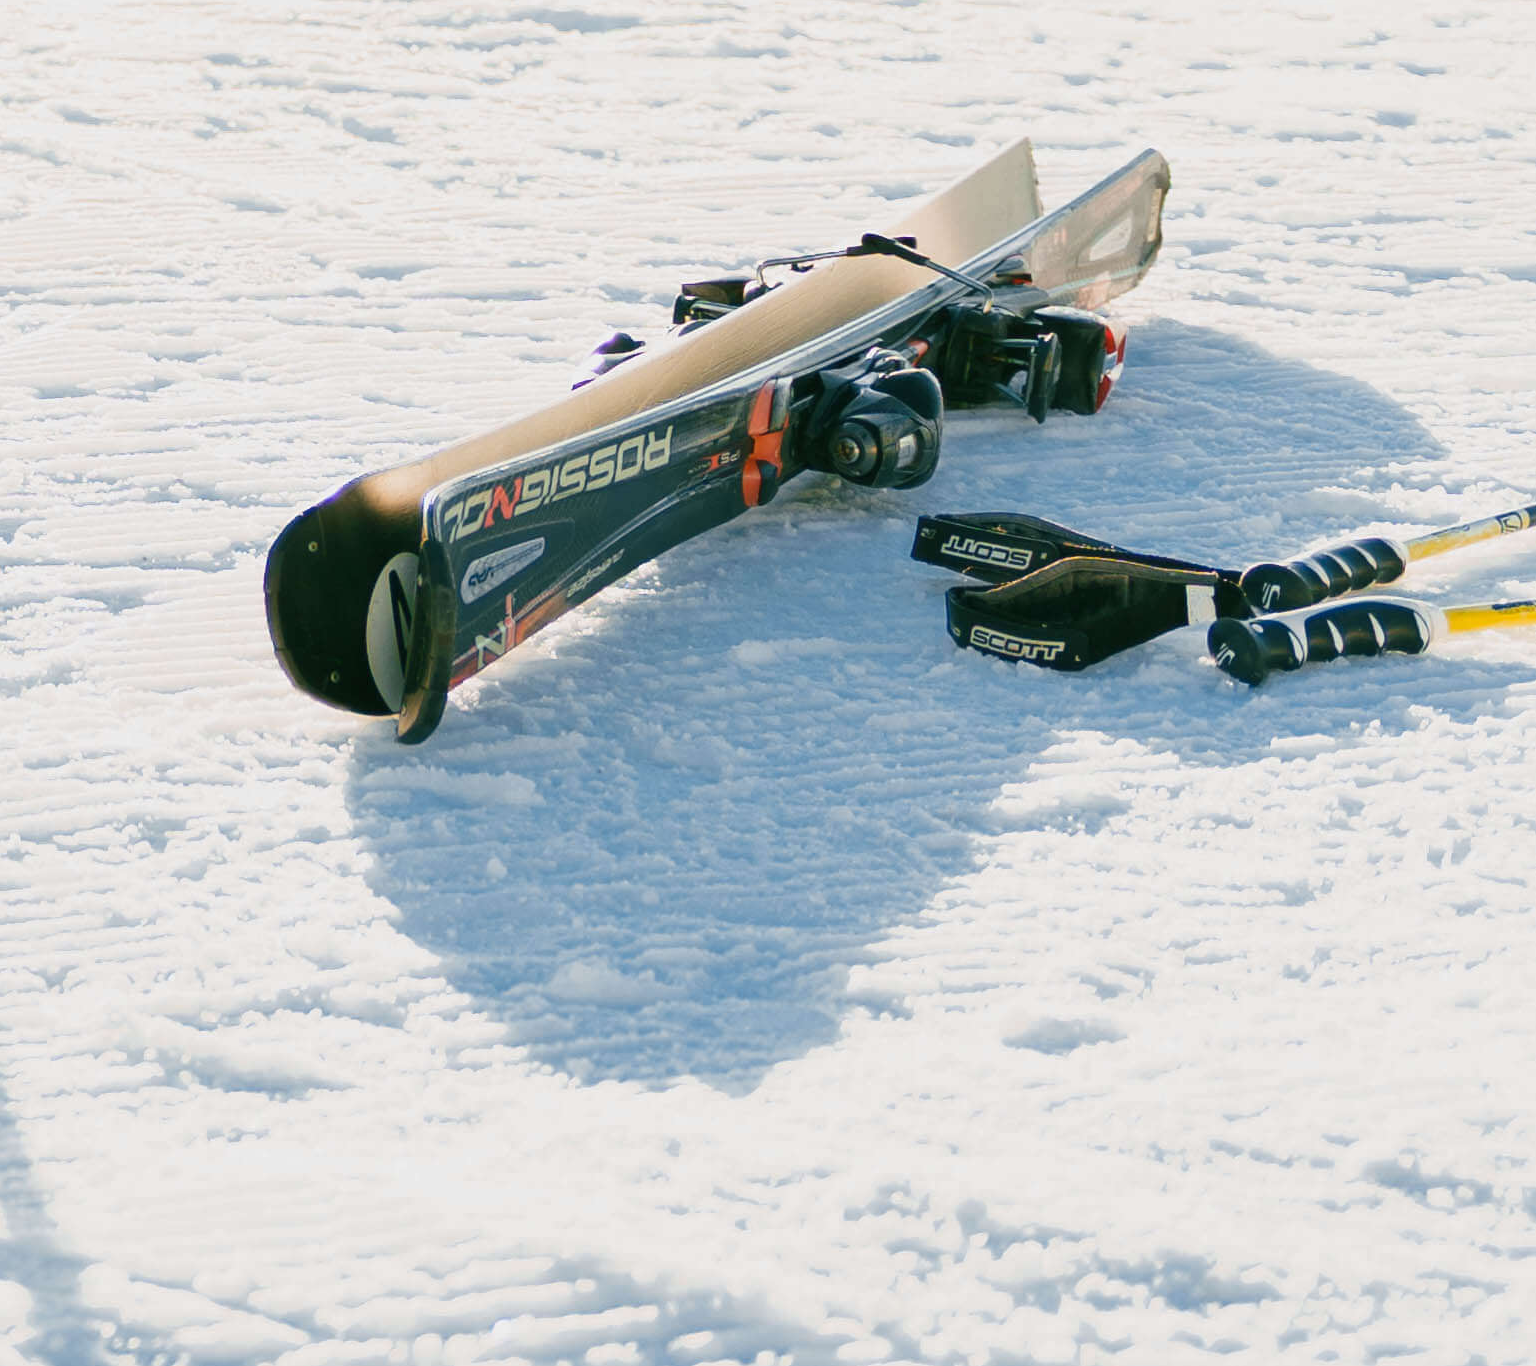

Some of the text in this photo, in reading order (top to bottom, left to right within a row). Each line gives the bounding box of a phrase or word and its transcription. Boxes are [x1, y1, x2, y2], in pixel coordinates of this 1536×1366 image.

[444, 425, 674, 544] ROSSIGNOL
[941, 534, 1034, 570] SCOTT
[969, 624, 1066, 661] SCOTT
